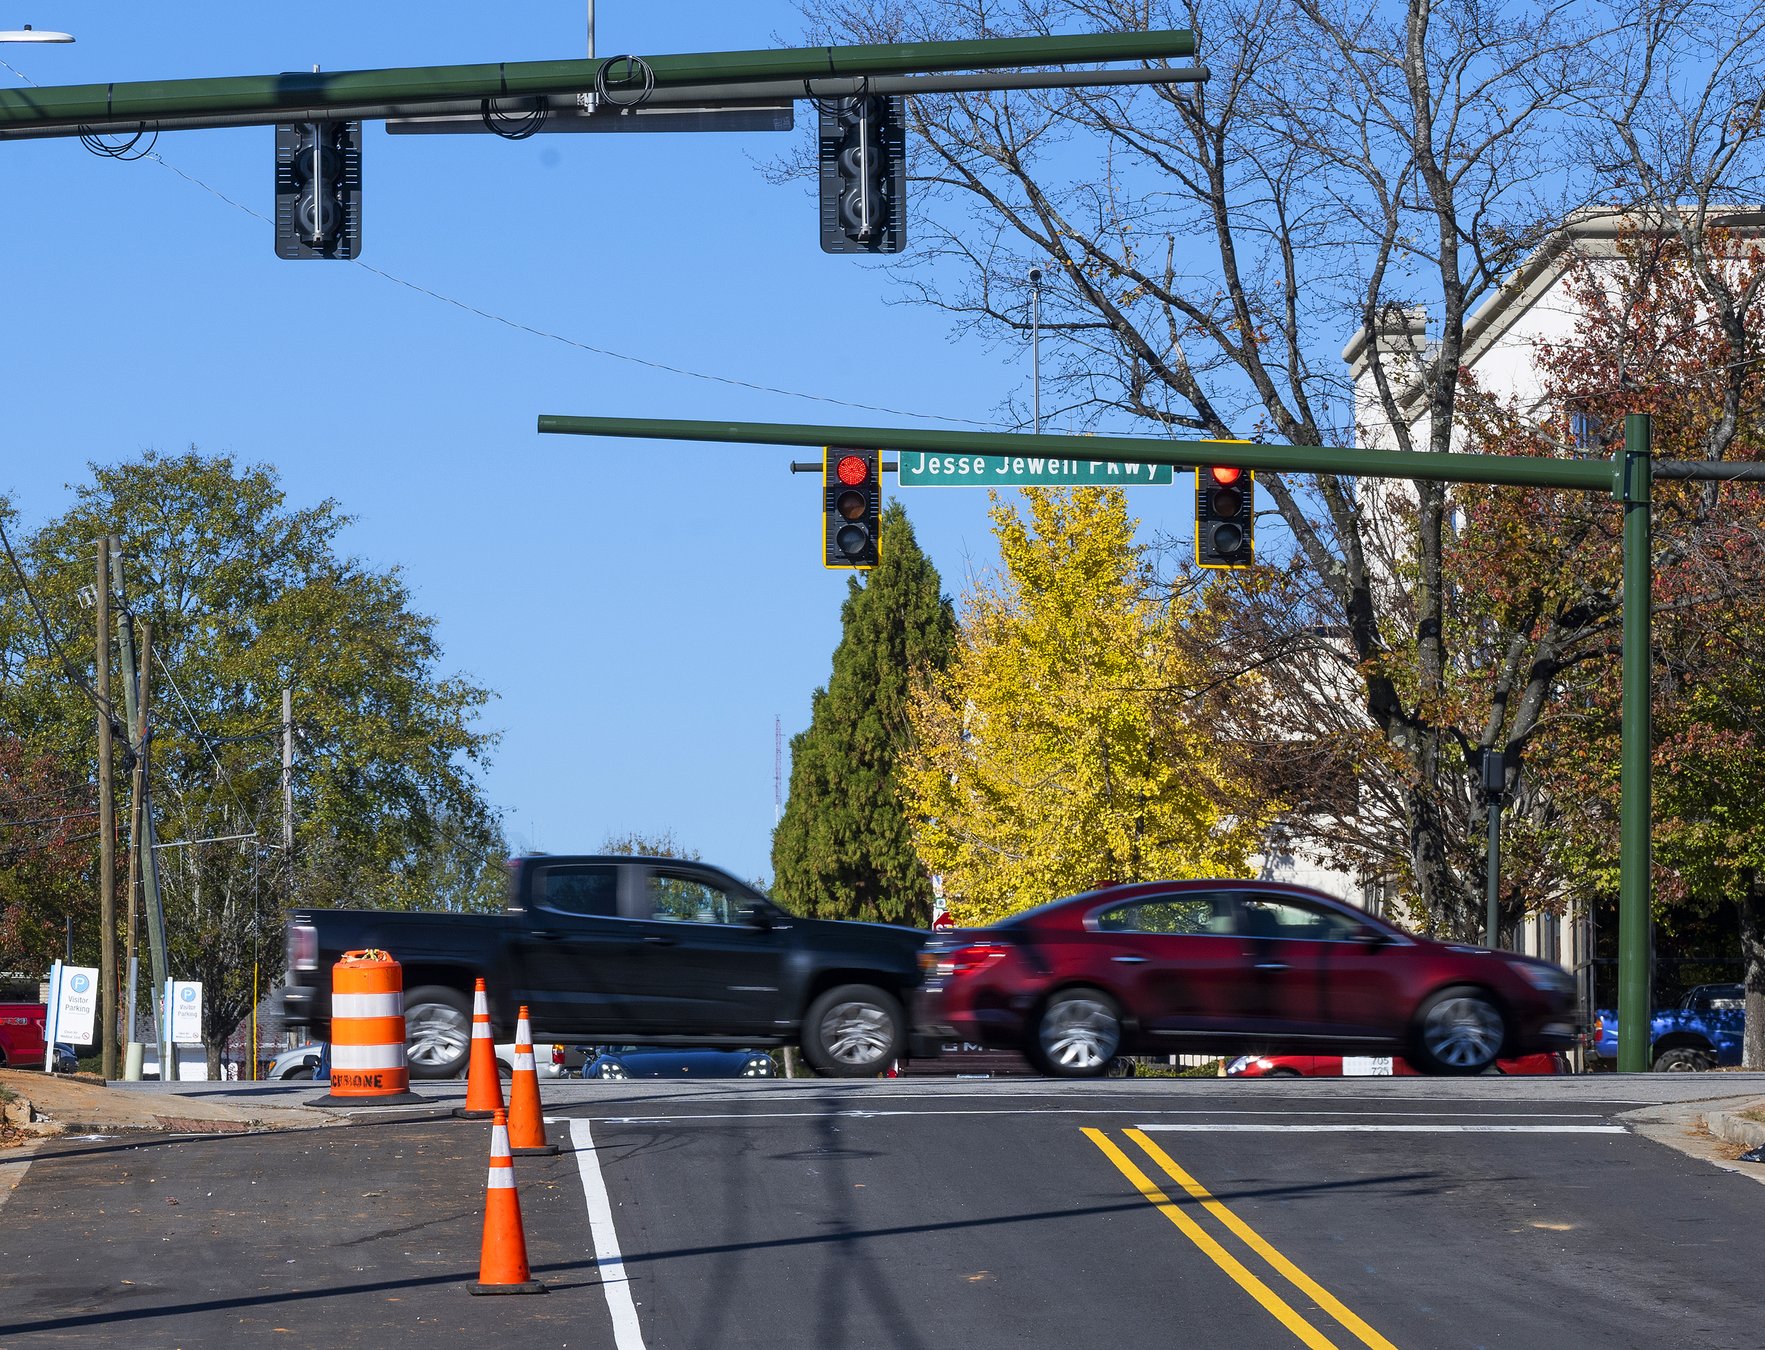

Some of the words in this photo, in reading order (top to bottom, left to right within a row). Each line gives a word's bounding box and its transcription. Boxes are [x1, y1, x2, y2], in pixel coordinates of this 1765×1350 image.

[911, 452, 985, 475] Jesse
[995, 456, 1078, 475] Jewell
[1089, 461, 1158, 481] Pkwy
[68, 995, 89, 1004] Visitor
[65, 1004, 90, 1014] Parking
